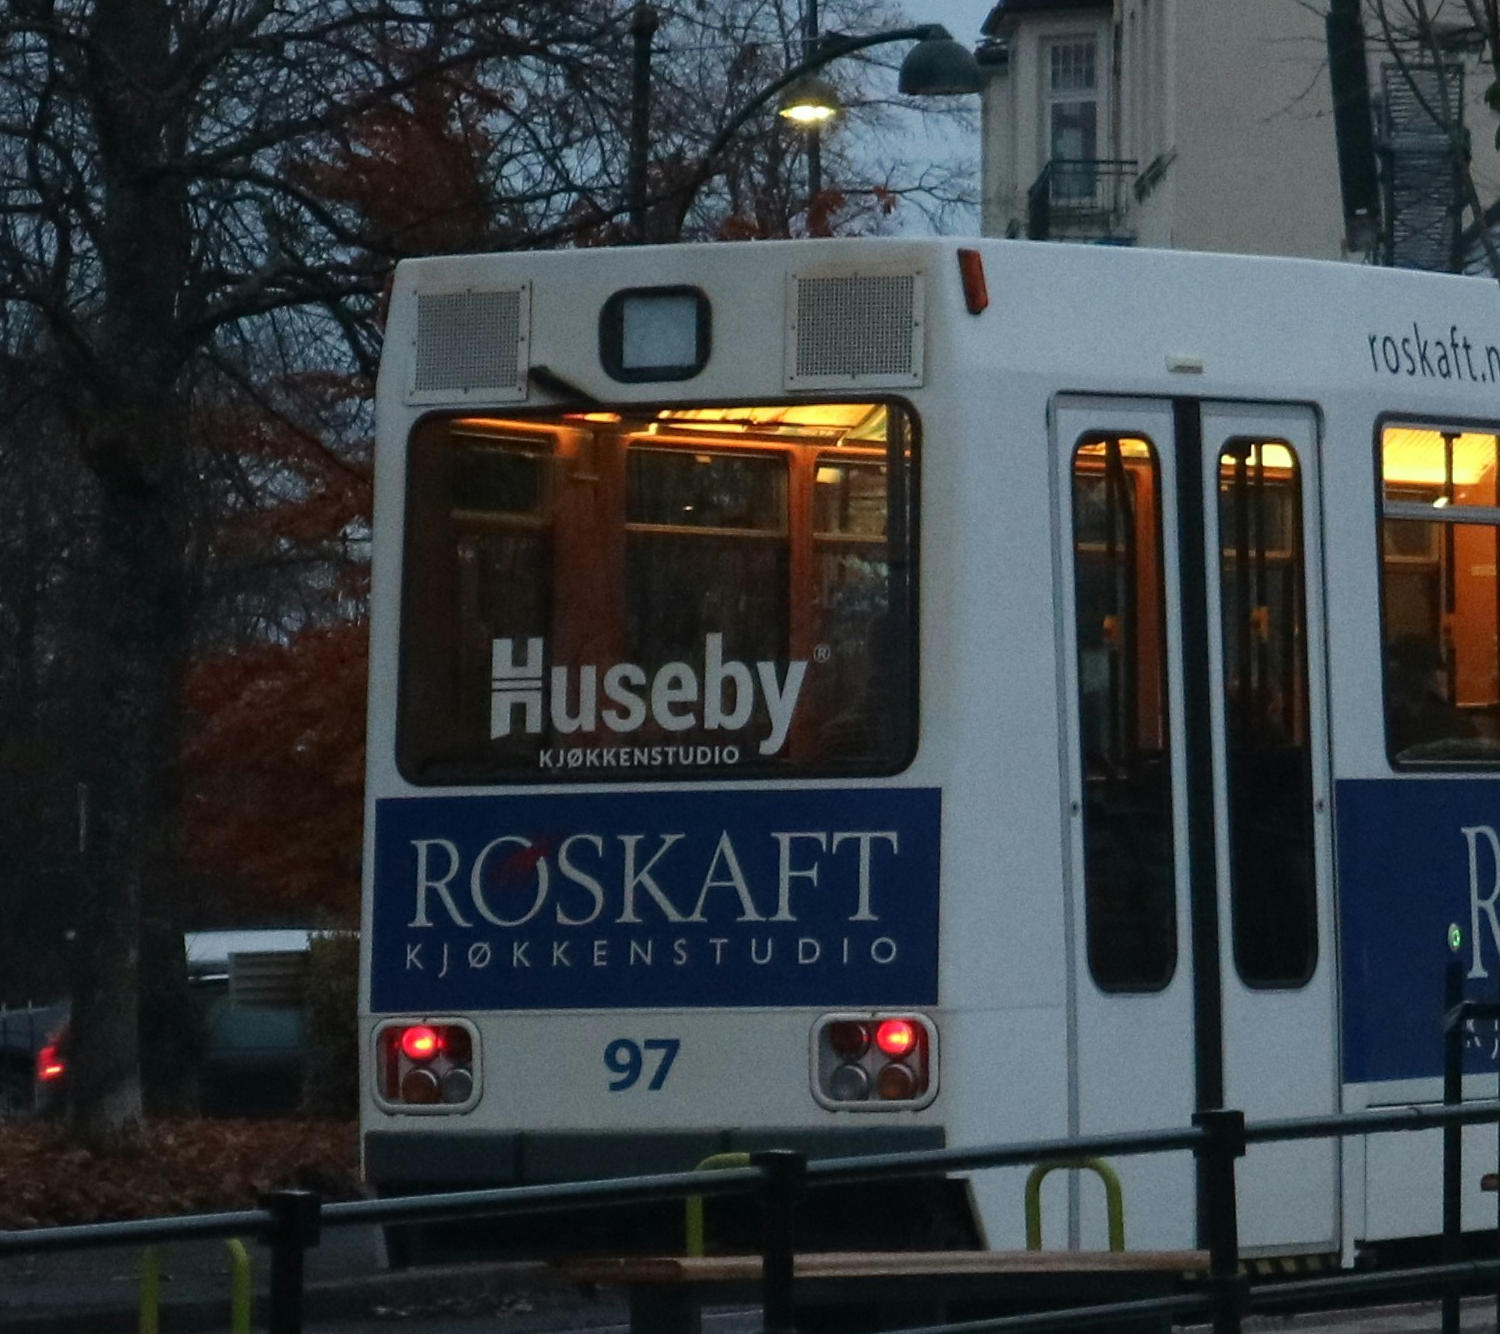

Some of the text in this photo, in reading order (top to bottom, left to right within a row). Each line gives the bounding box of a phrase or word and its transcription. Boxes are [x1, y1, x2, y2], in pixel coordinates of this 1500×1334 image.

[490, 633, 808, 755] Huseby
[538, 744, 740, 768] KJØKKENSTUDIO
[406, 829, 899, 929] ROSKAFT
[405, 935, 899, 978] KJØKKENSTUDIO
[602, 1037, 681, 1092] 97
